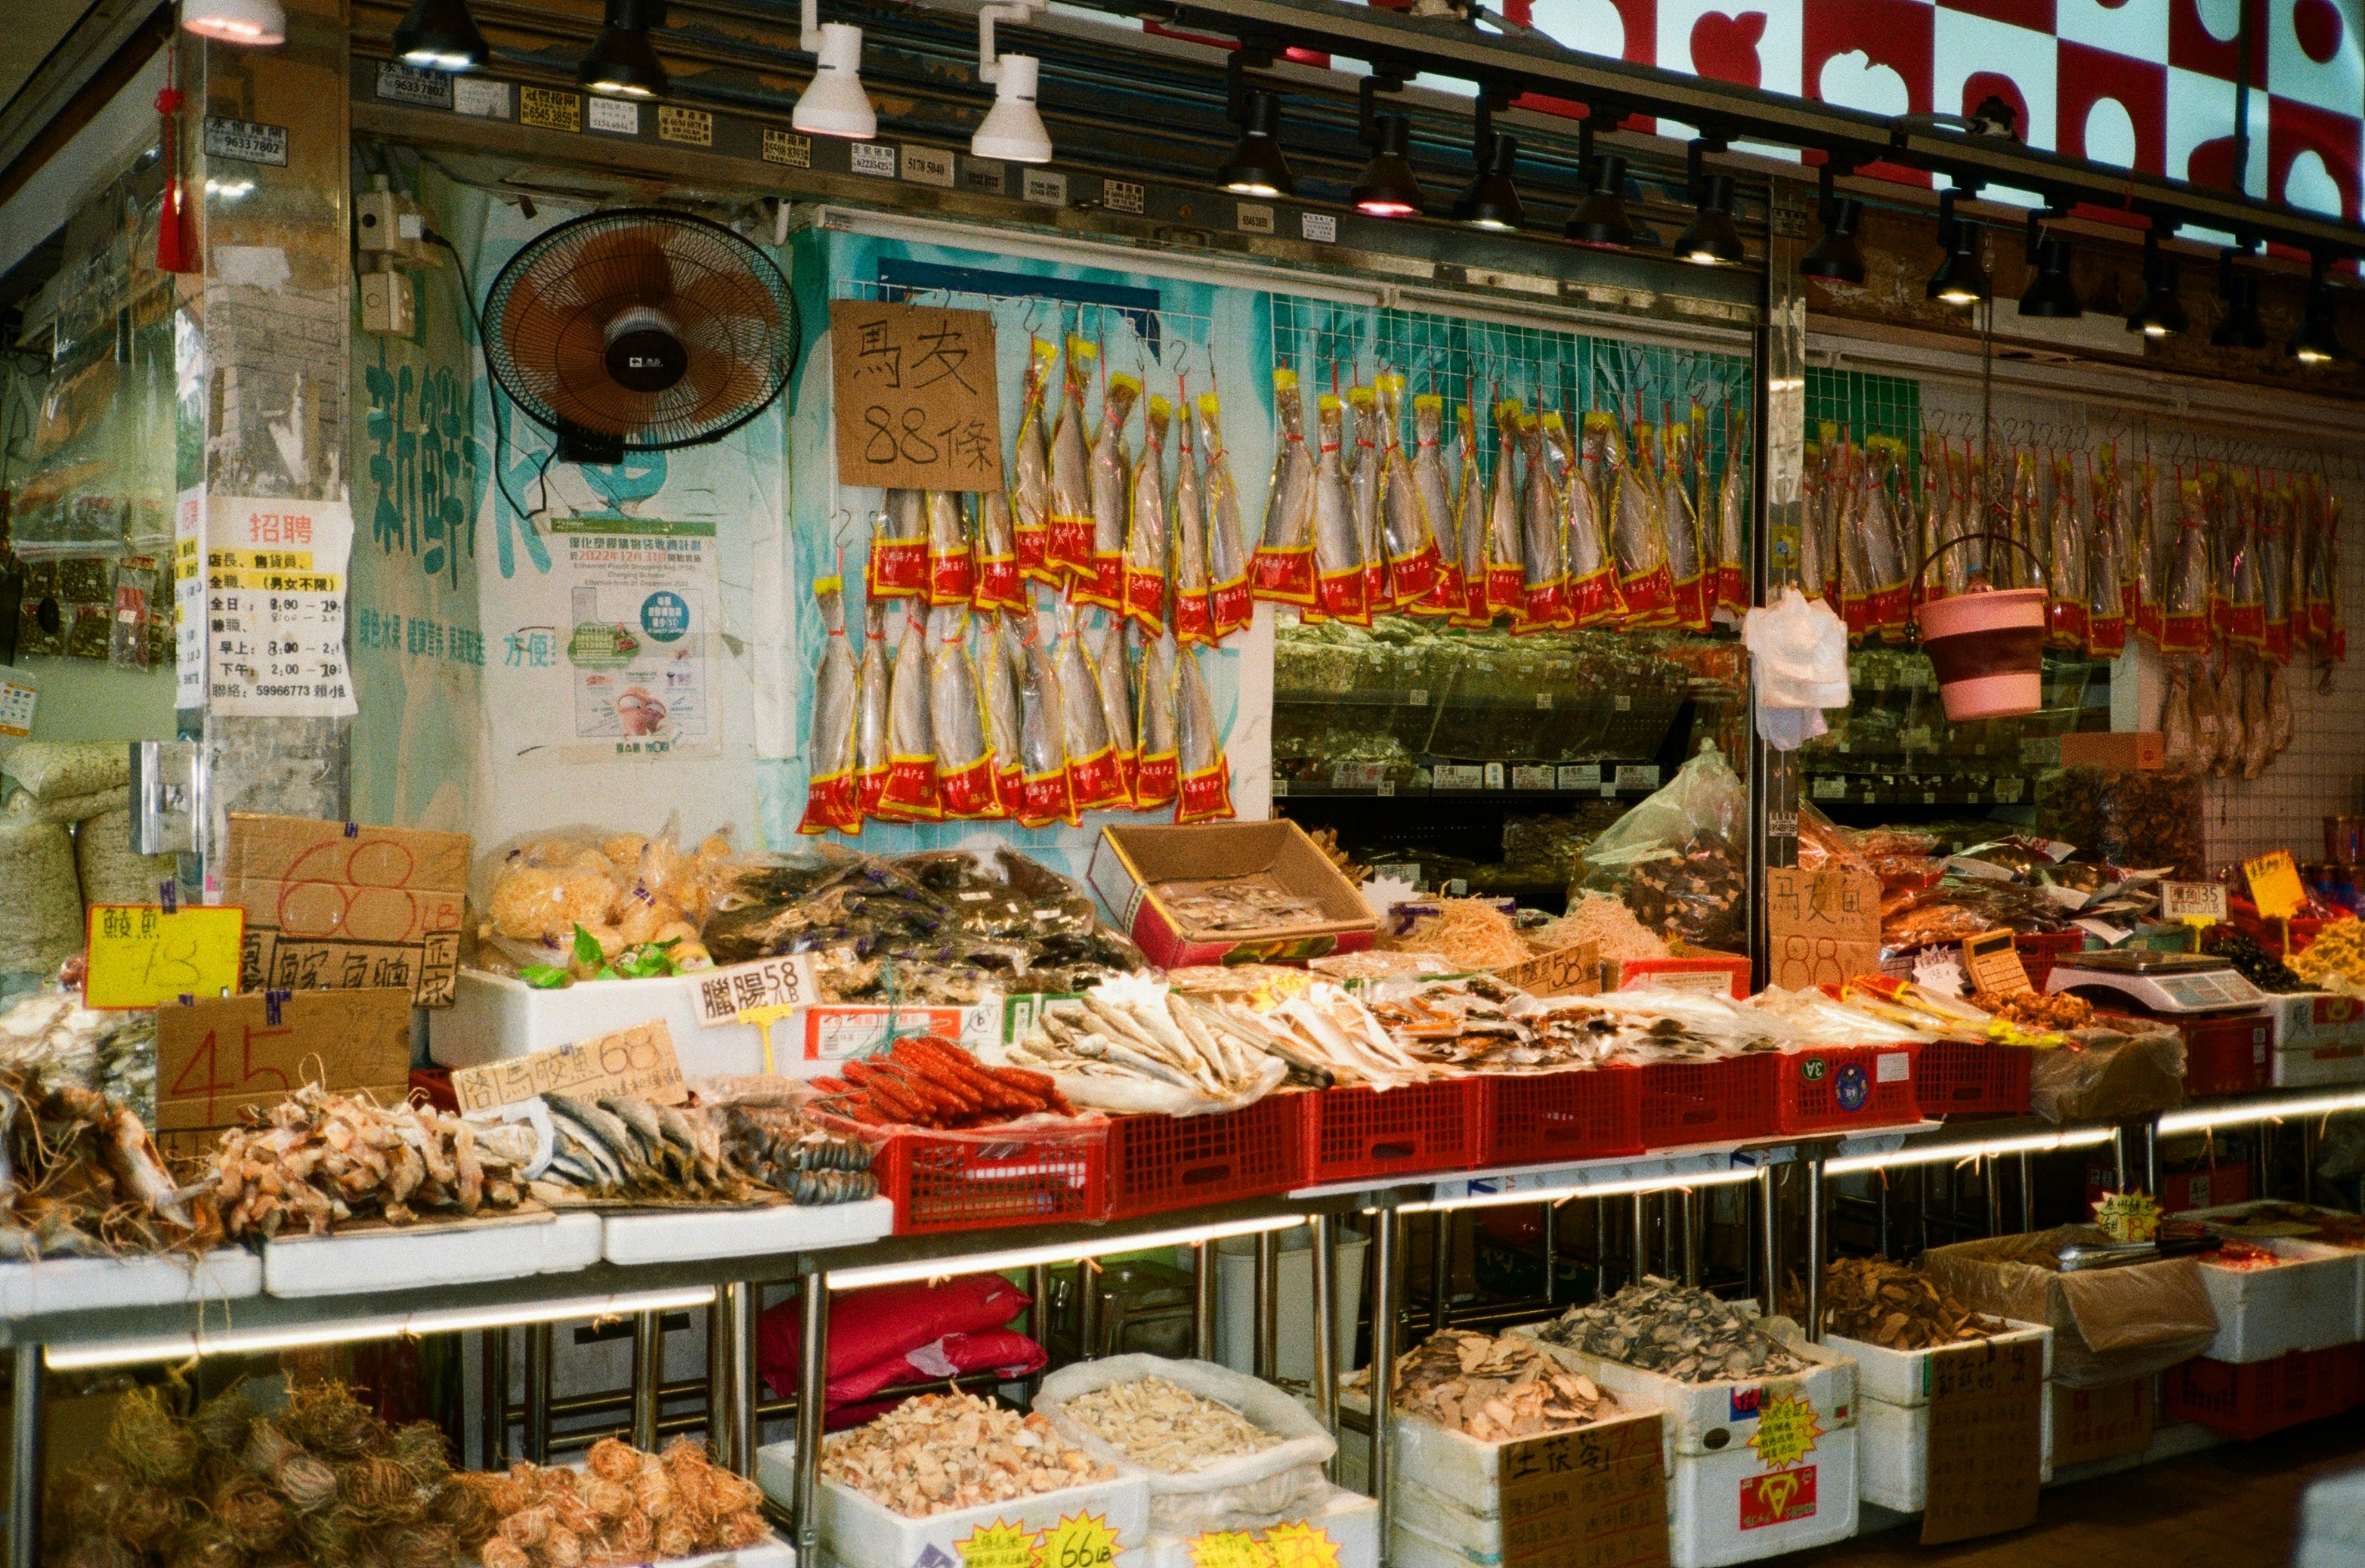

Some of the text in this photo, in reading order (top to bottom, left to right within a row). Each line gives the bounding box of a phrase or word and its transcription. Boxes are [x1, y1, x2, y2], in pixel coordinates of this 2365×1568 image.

[395, 79, 445, 97] 9633 7802
[529, 108, 573, 124] 6545 3859
[224, 135, 280, 154] 9633 7802
[907, 156, 926, 172] 5178
[853, 319, 978, 395] 馬友
[249, 512, 313, 545] 招聘
[503, 632, 557, 668] 方便
[255, 685, 311, 697] 59966773
[277, 840, 416, 942] 68
[422, 936, 455, 1004] 正宗
[763, 961, 799, 991] 58
[1551, 946, 1583, 988] 58
[1780, 934, 1844, 990] 88
[598, 1026, 660, 1077] 68
[171, 1025, 293, 1127] 45
[1513, 1431, 1602, 1480] 土茯苓
[1060, 1531, 1093, 1568] 66
